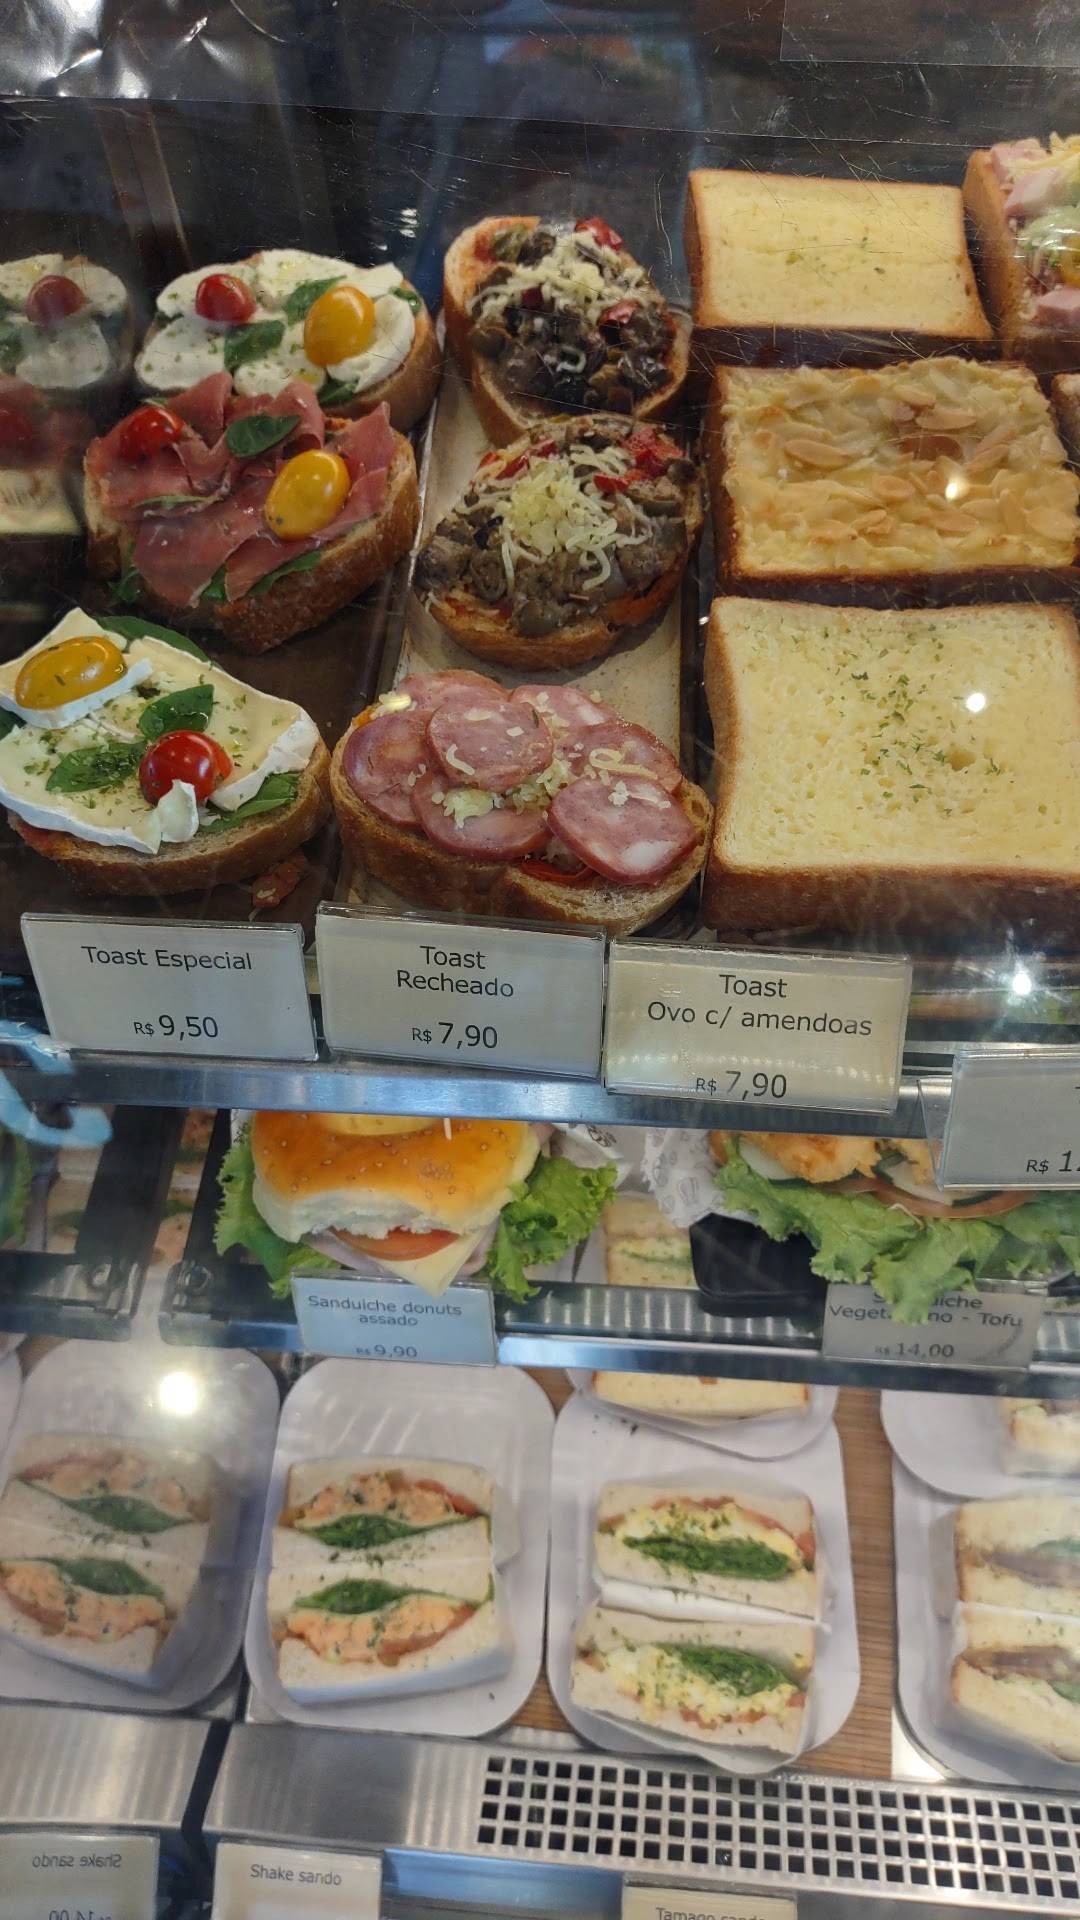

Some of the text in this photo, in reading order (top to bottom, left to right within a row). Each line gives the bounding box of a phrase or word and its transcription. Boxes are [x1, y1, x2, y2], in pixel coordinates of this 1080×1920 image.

[81, 945, 252, 971] Toast Especial
[419, 945, 486, 970] Toast
[396, 969, 514, 997] Recheado
[719, 974, 788, 998] Toast
[133, 1014, 219, 1041] R$ 9,50
[647, 1001, 872, 1036] Ovo c/ amendoas
[411, 1022, 498, 1050] R$ 7,90
[696, 1070, 788, 1100] R$ 7,90
[1026, 1150, 1080, 1175] R$ 1
[359, 1313, 419, 1327] assado
[403, 1301, 463, 1316] donuts
[829, 1305, 953, 1323] Vegetno
[976, 1312, 1023, 1328] Tofu
[374, 1344, 418, 1359] 9,90
[895, 1342, 955, 1359] 14,00
[250, 1863, 342, 1886] Shake sando
